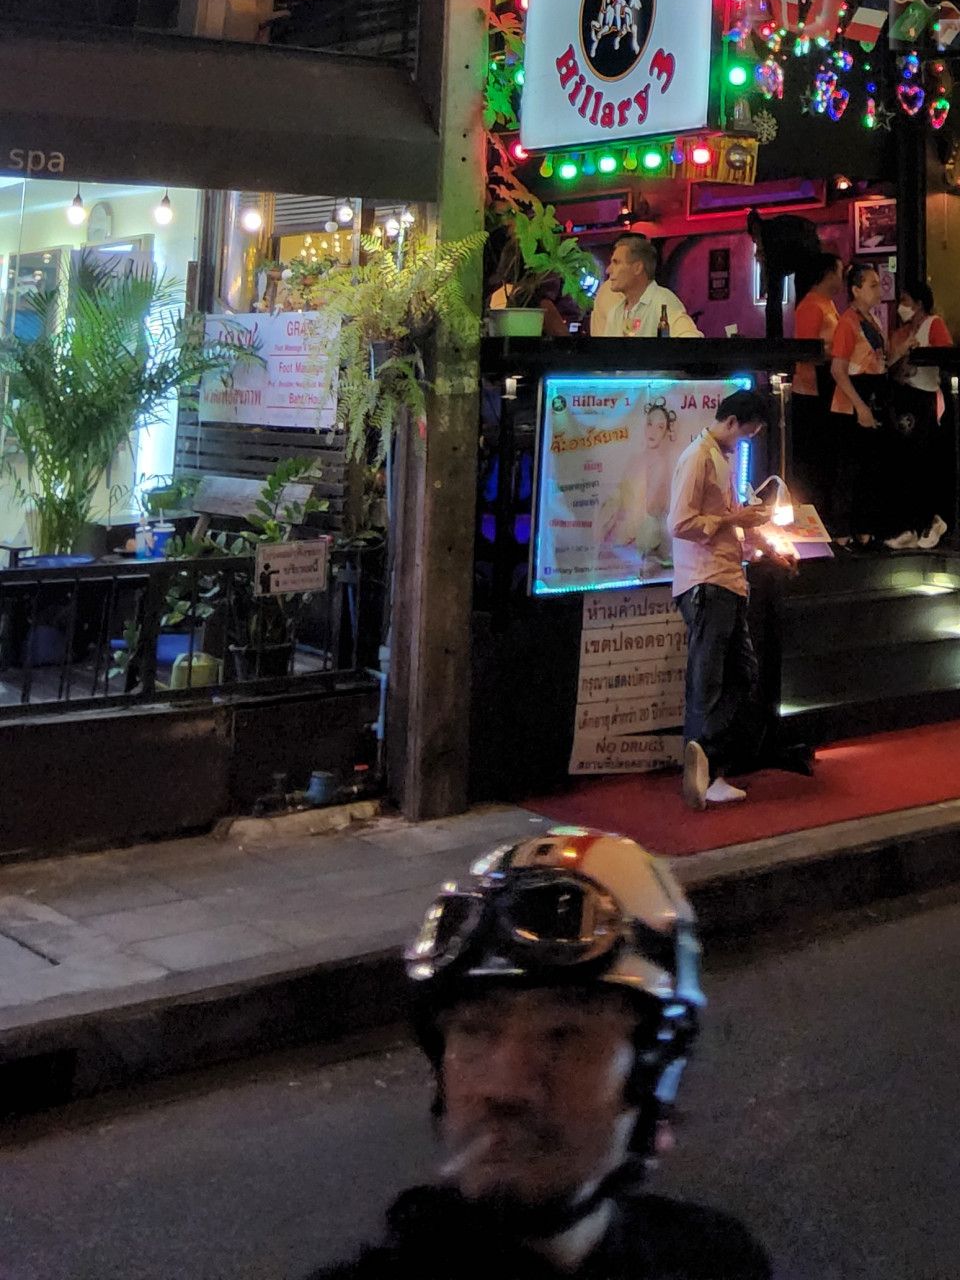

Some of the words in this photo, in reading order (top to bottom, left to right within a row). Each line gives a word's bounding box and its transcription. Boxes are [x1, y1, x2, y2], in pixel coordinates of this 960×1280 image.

[555, 43, 651, 129] Hillary
[649, 47, 677, 94] 3
[8, 145, 66, 174] spa
[572, 394, 618, 409] Hillary
[680, 395, 698, 410] JA
[587, 596, 679, 621] ห้ามค้าประเว
[595, 740, 617, 754] NO
[620, 740, 666, 754] DRUGS
